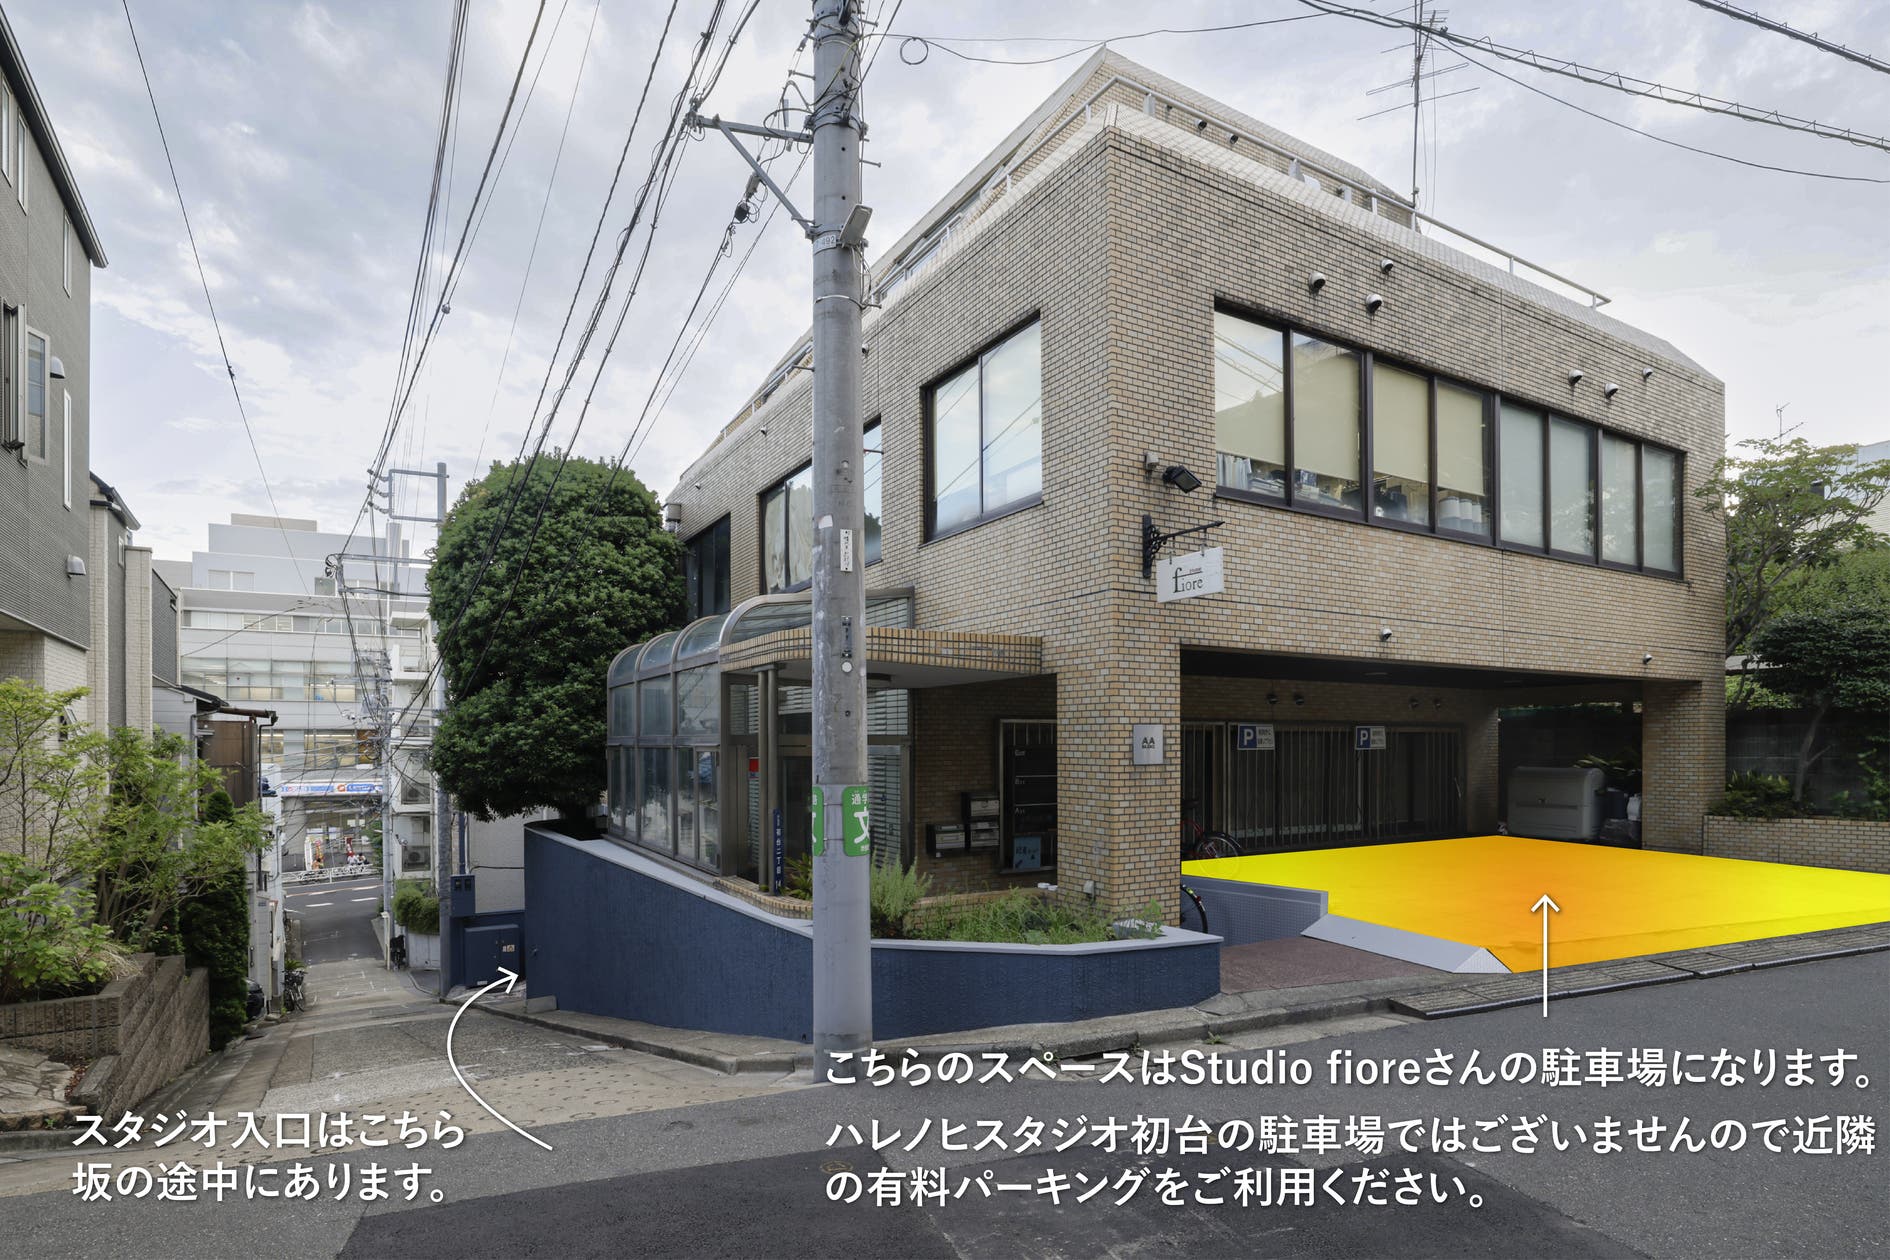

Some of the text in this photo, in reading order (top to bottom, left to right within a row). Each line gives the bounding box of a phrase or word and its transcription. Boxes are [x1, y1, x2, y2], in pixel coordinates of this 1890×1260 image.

[1172, 567, 1204, 593] fiore
[1243, 728, 1254, 746] P
[1360, 730, 1369, 746] P
